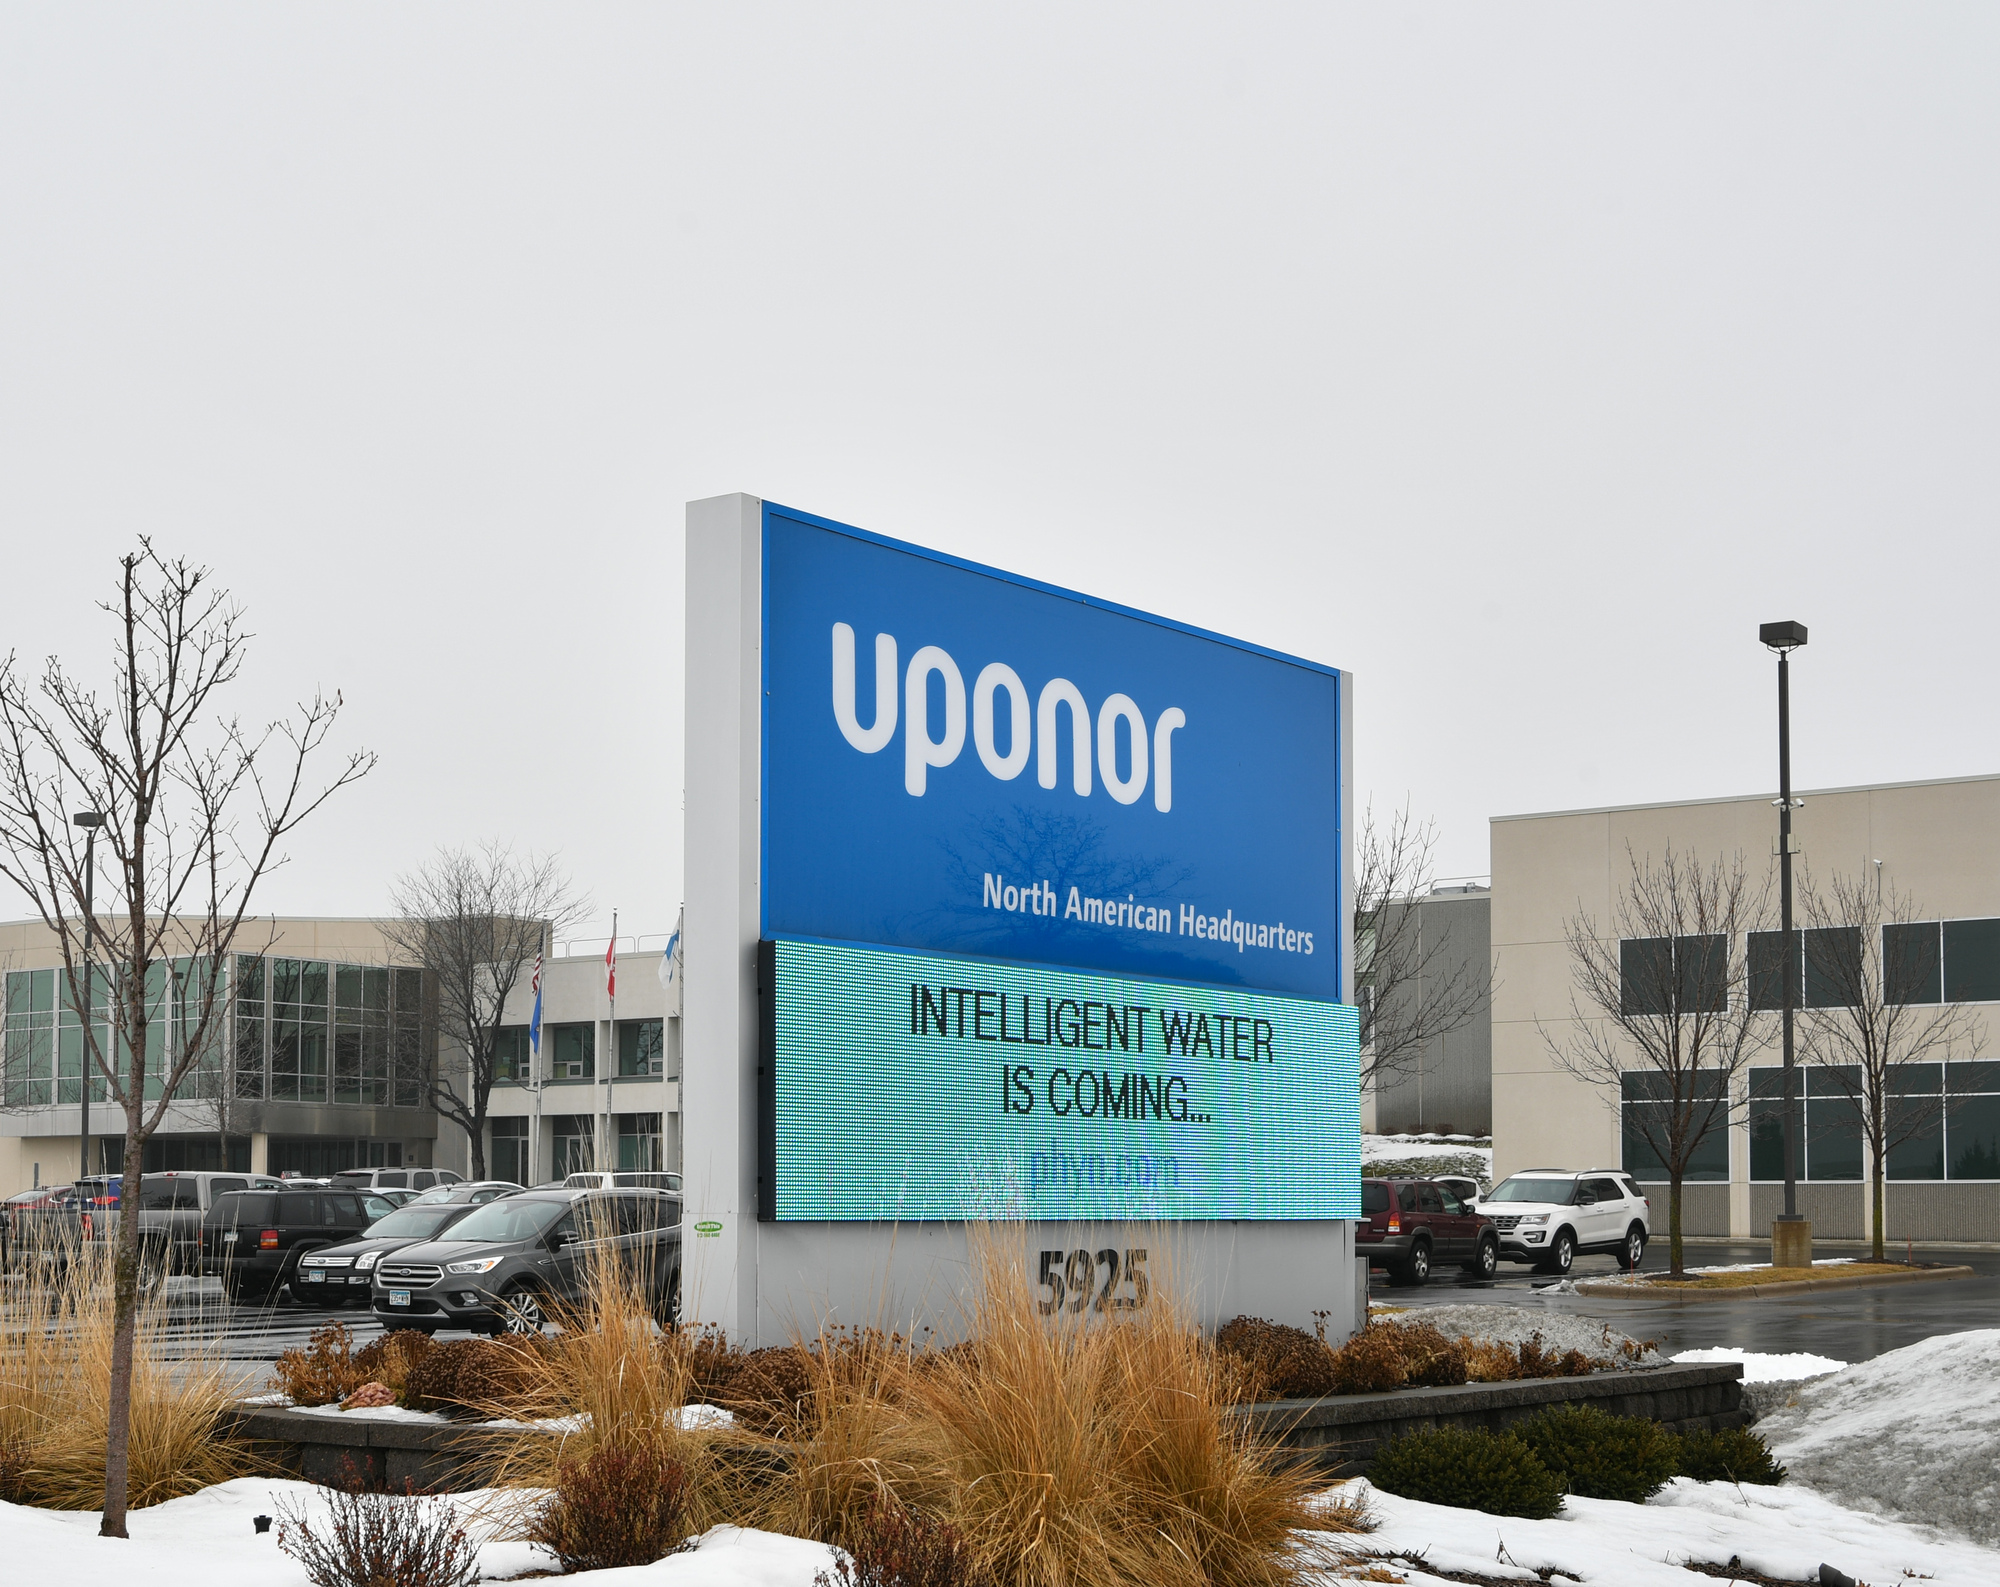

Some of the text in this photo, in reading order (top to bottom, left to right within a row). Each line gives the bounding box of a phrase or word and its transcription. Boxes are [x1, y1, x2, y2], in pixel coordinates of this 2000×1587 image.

[832, 622, 1186, 813] uponor
[983, 872, 1314, 955] North American Headquarters
[911, 983, 1274, 1063] INTELLIGENT WATER
[1003, 1064, 1211, 1122] IS COMING...
[1030, 1137, 1179, 1199] phyn.com
[1039, 1248, 1149, 1316] 5925
